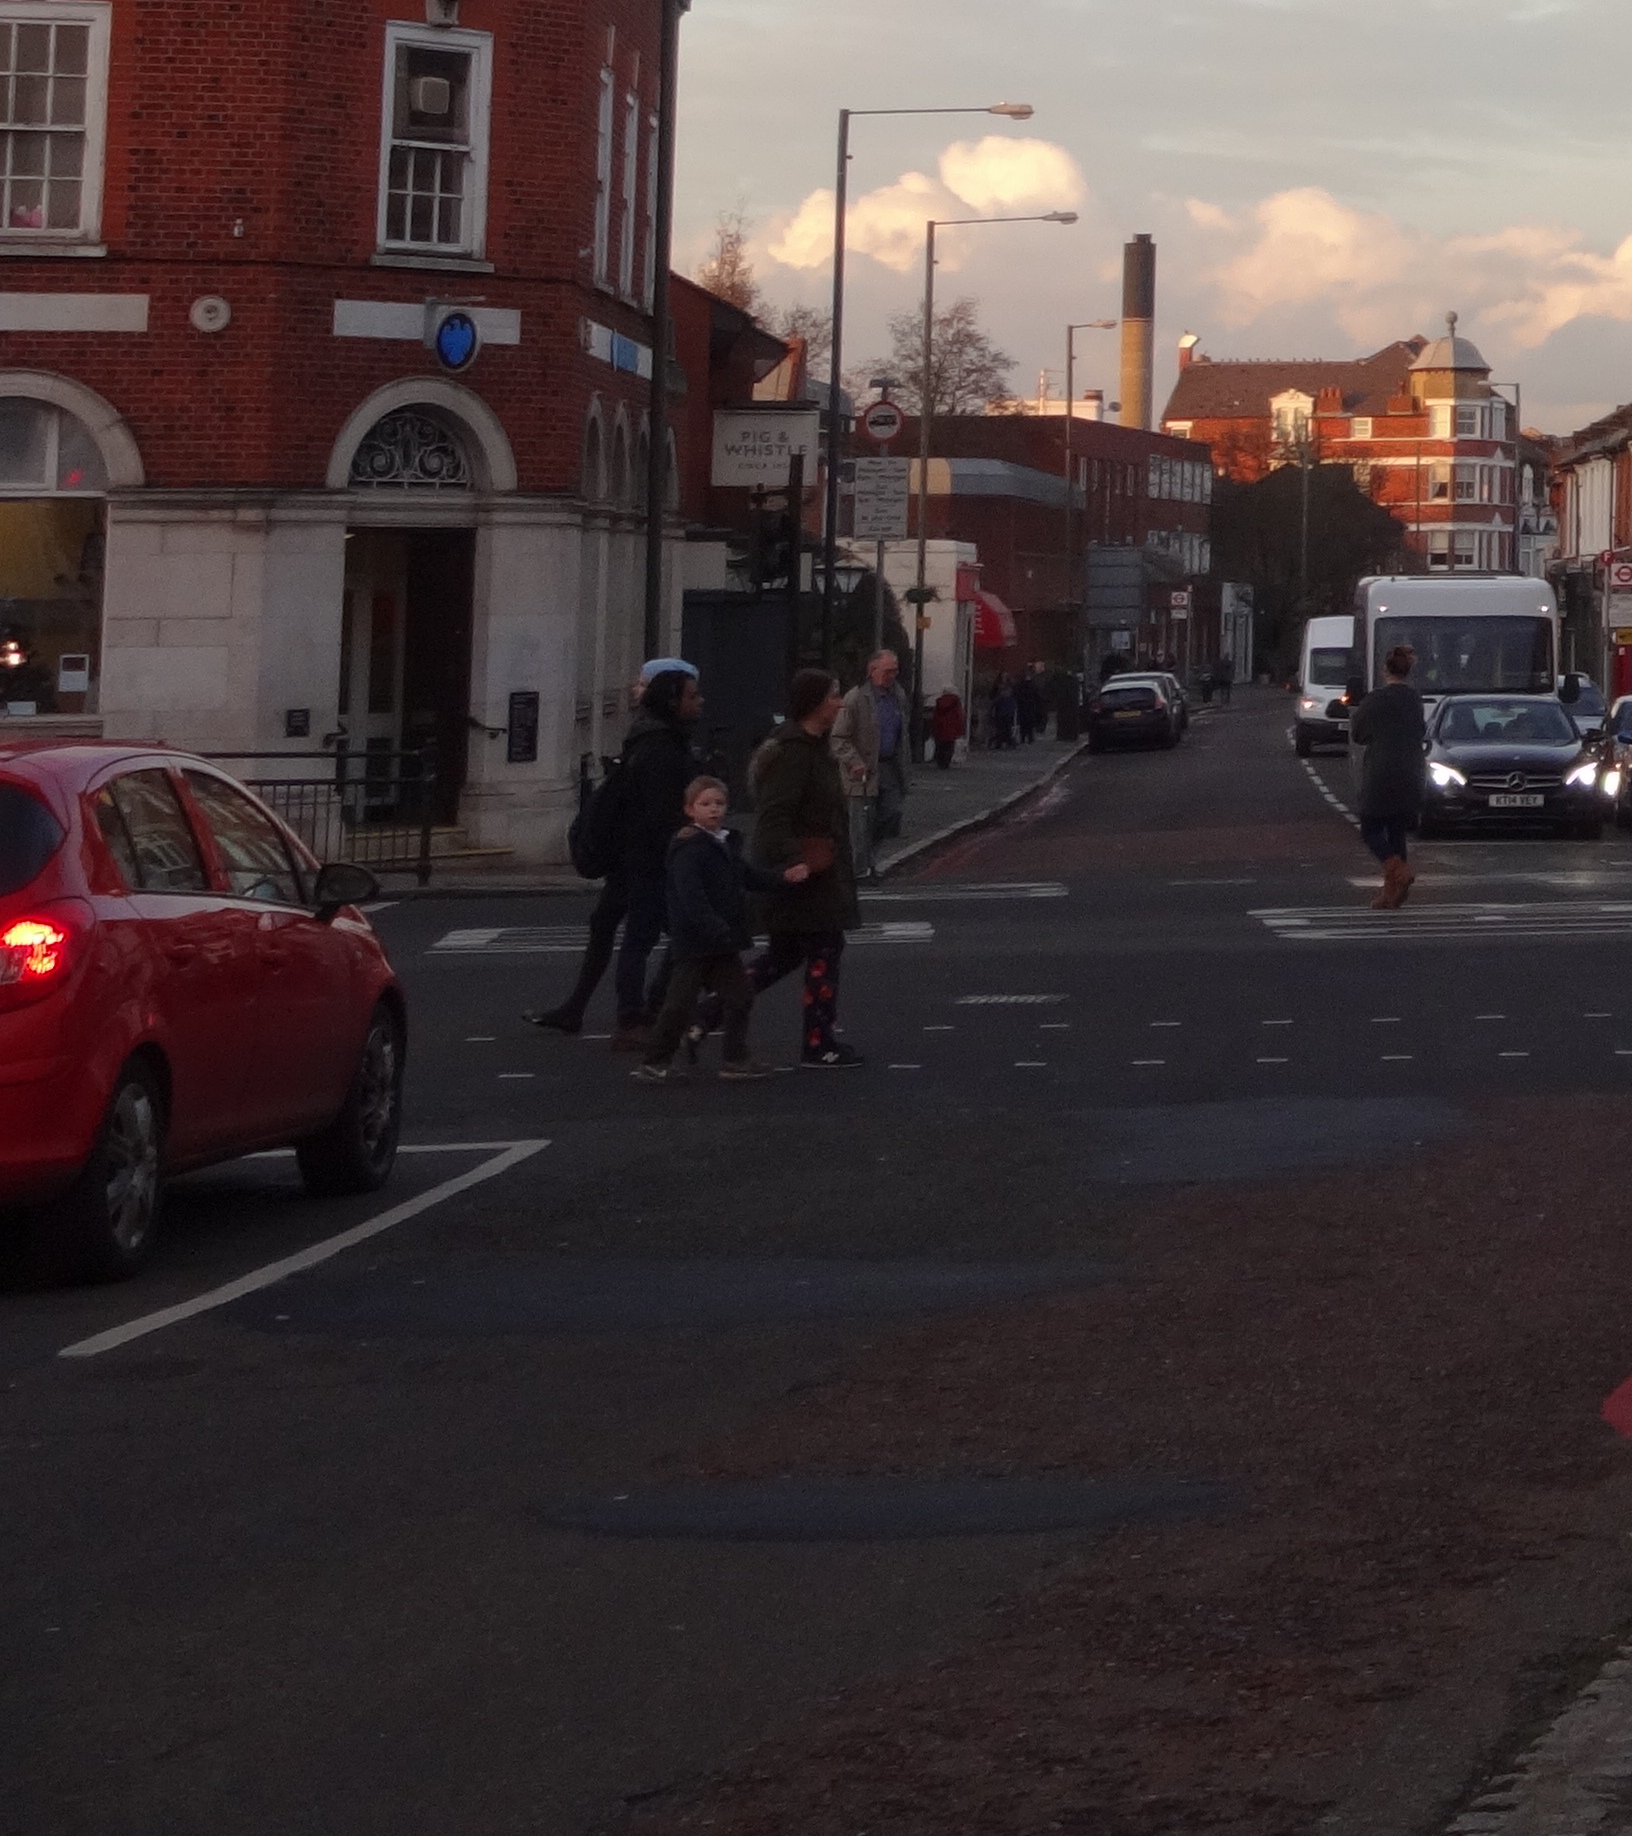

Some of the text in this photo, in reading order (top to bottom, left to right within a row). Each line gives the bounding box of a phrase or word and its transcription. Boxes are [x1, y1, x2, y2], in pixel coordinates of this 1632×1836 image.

[741, 430, 788, 443] PIG &
[725, 444, 808, 456] WHISTLE
